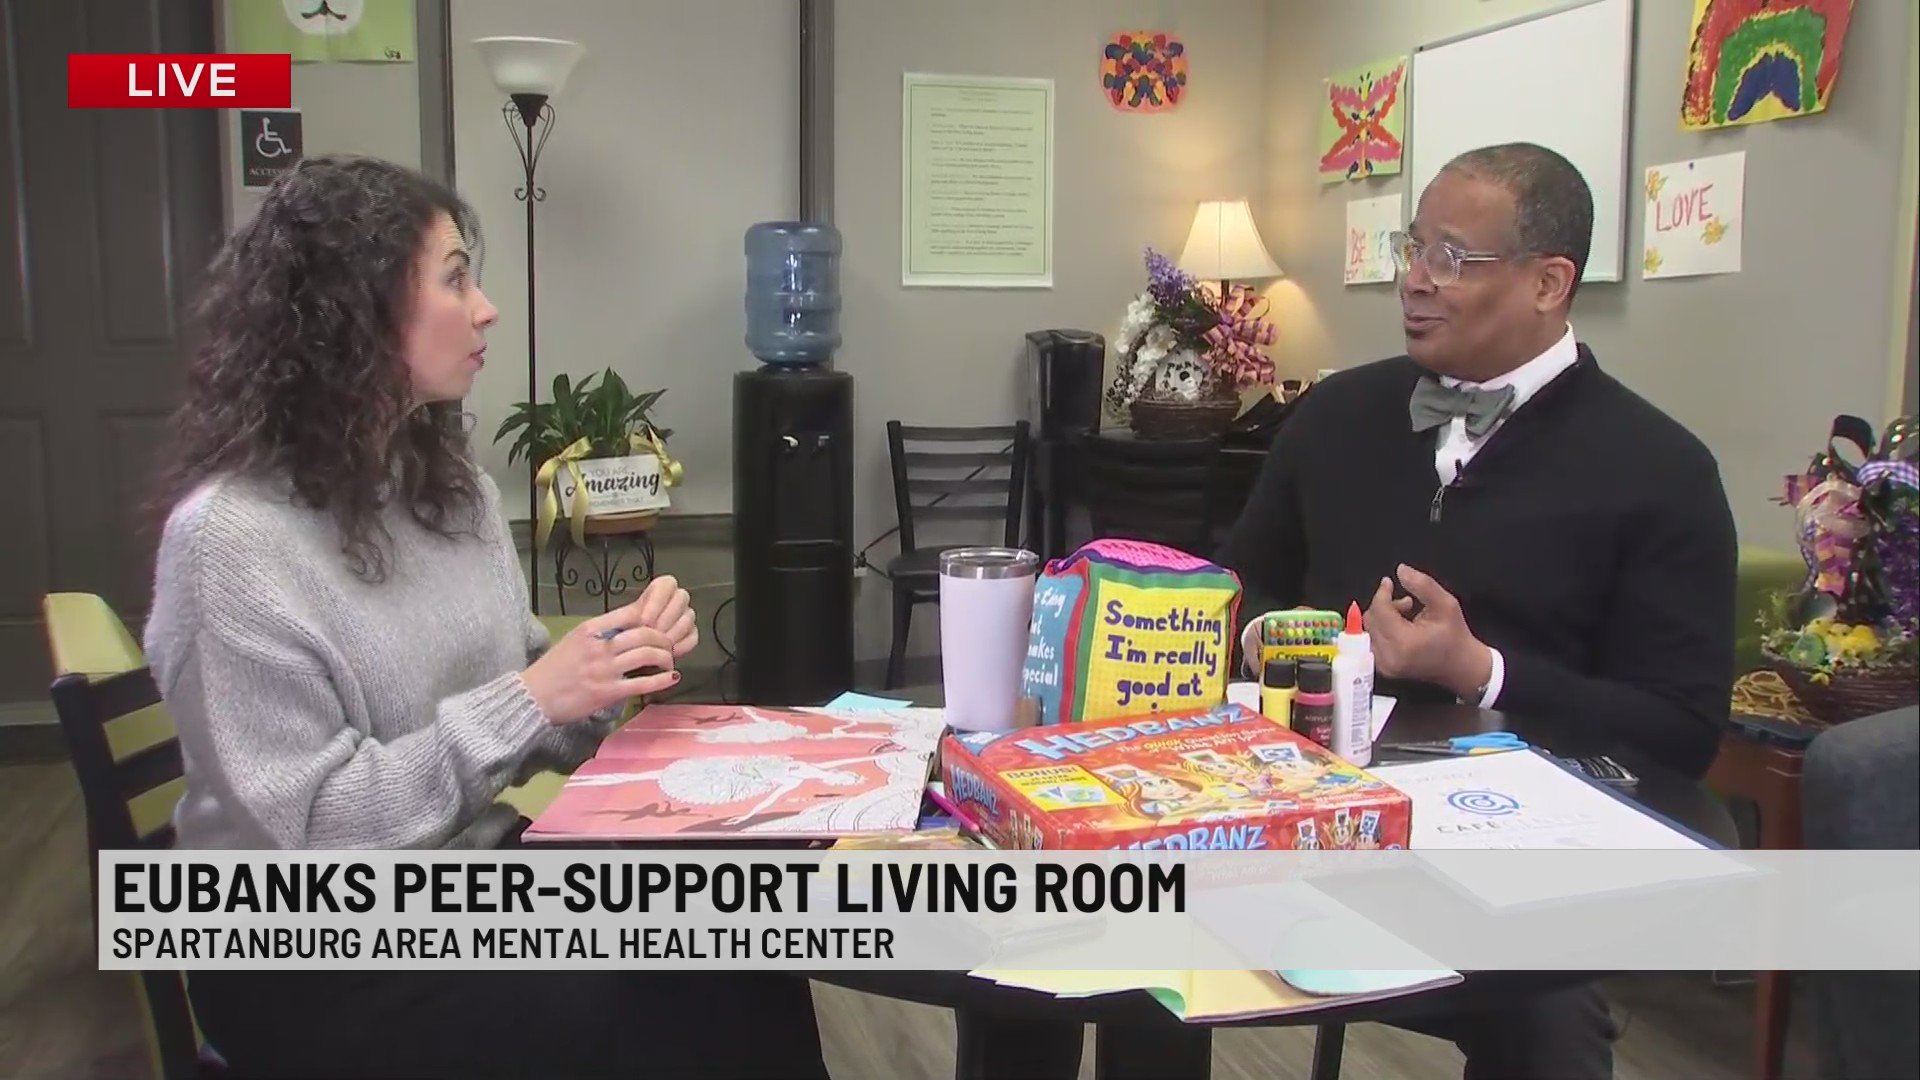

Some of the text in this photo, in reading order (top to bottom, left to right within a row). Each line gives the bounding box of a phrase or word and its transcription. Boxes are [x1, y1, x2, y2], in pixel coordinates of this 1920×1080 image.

[1656, 183, 1714, 232] LOVE
[1103, 599, 1222, 646] Something
[1022, 663, 1059, 690] pecial
[1104, 634, 1218, 677] I'm really
[1116, 672, 1204, 706] good at
[1013, 703, 1252, 761] HEDBANZ
[949, 763, 999, 816] HEDBANZ
